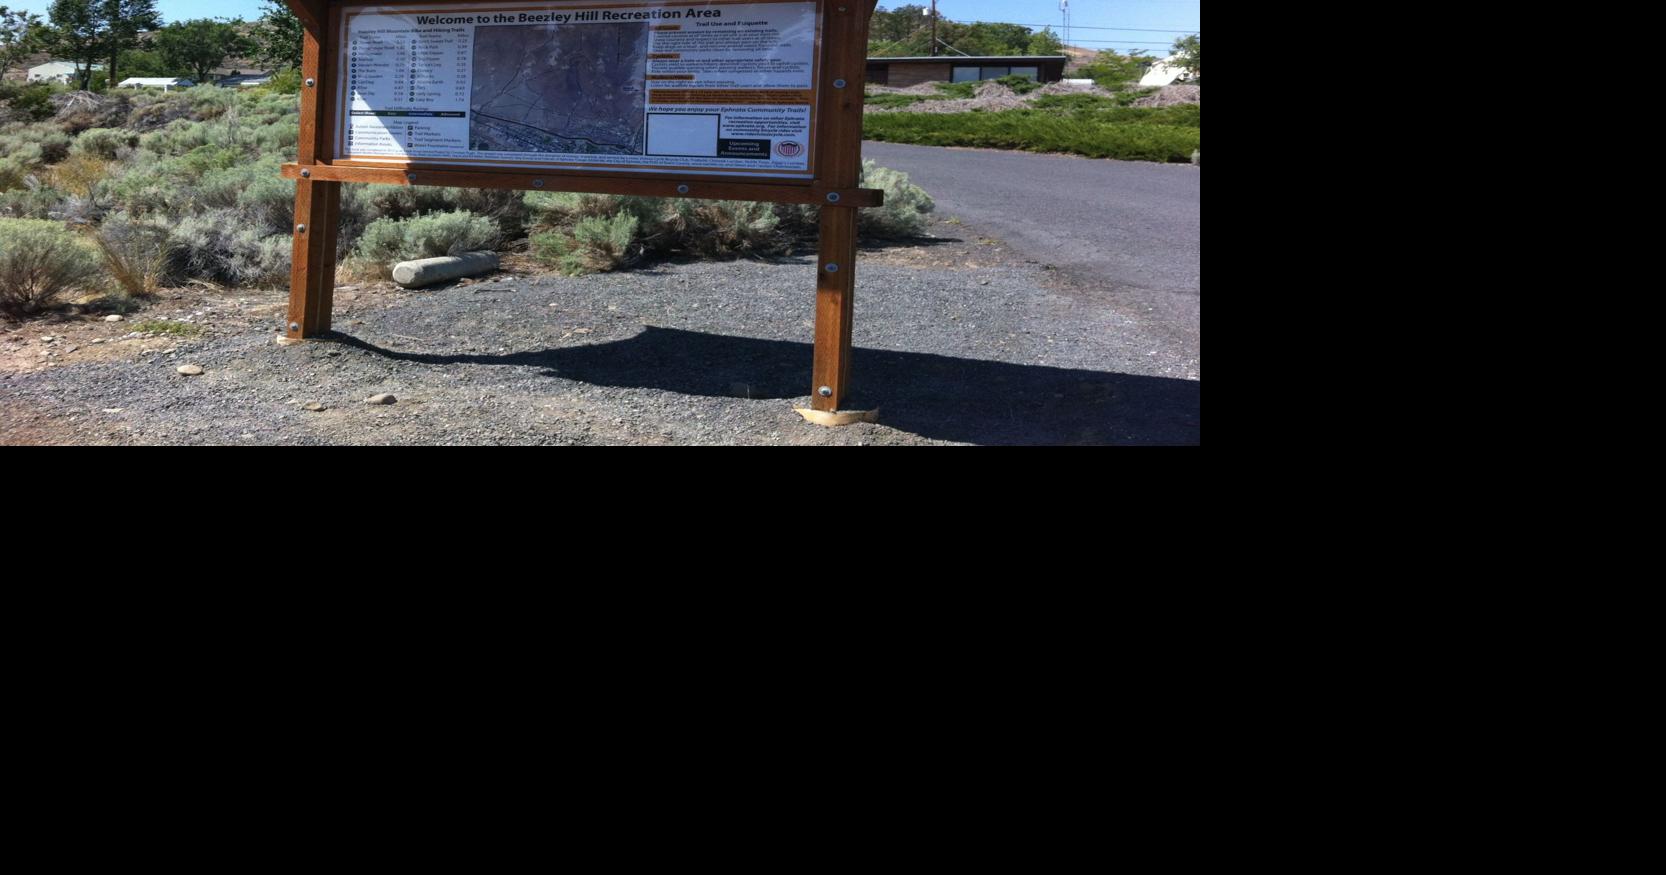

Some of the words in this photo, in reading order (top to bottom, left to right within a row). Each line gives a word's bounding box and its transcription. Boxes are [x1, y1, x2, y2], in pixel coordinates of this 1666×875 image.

[417, 15, 474, 26] Welcome
[476, 14, 490, 24] to
[492, 14, 515, 24] the
[518, 12, 572, 24] Beezley
[575, 10, 599, 21] Hill
[602, 8, 684, 20] Recreation
[686, 7, 722, 18] Area
